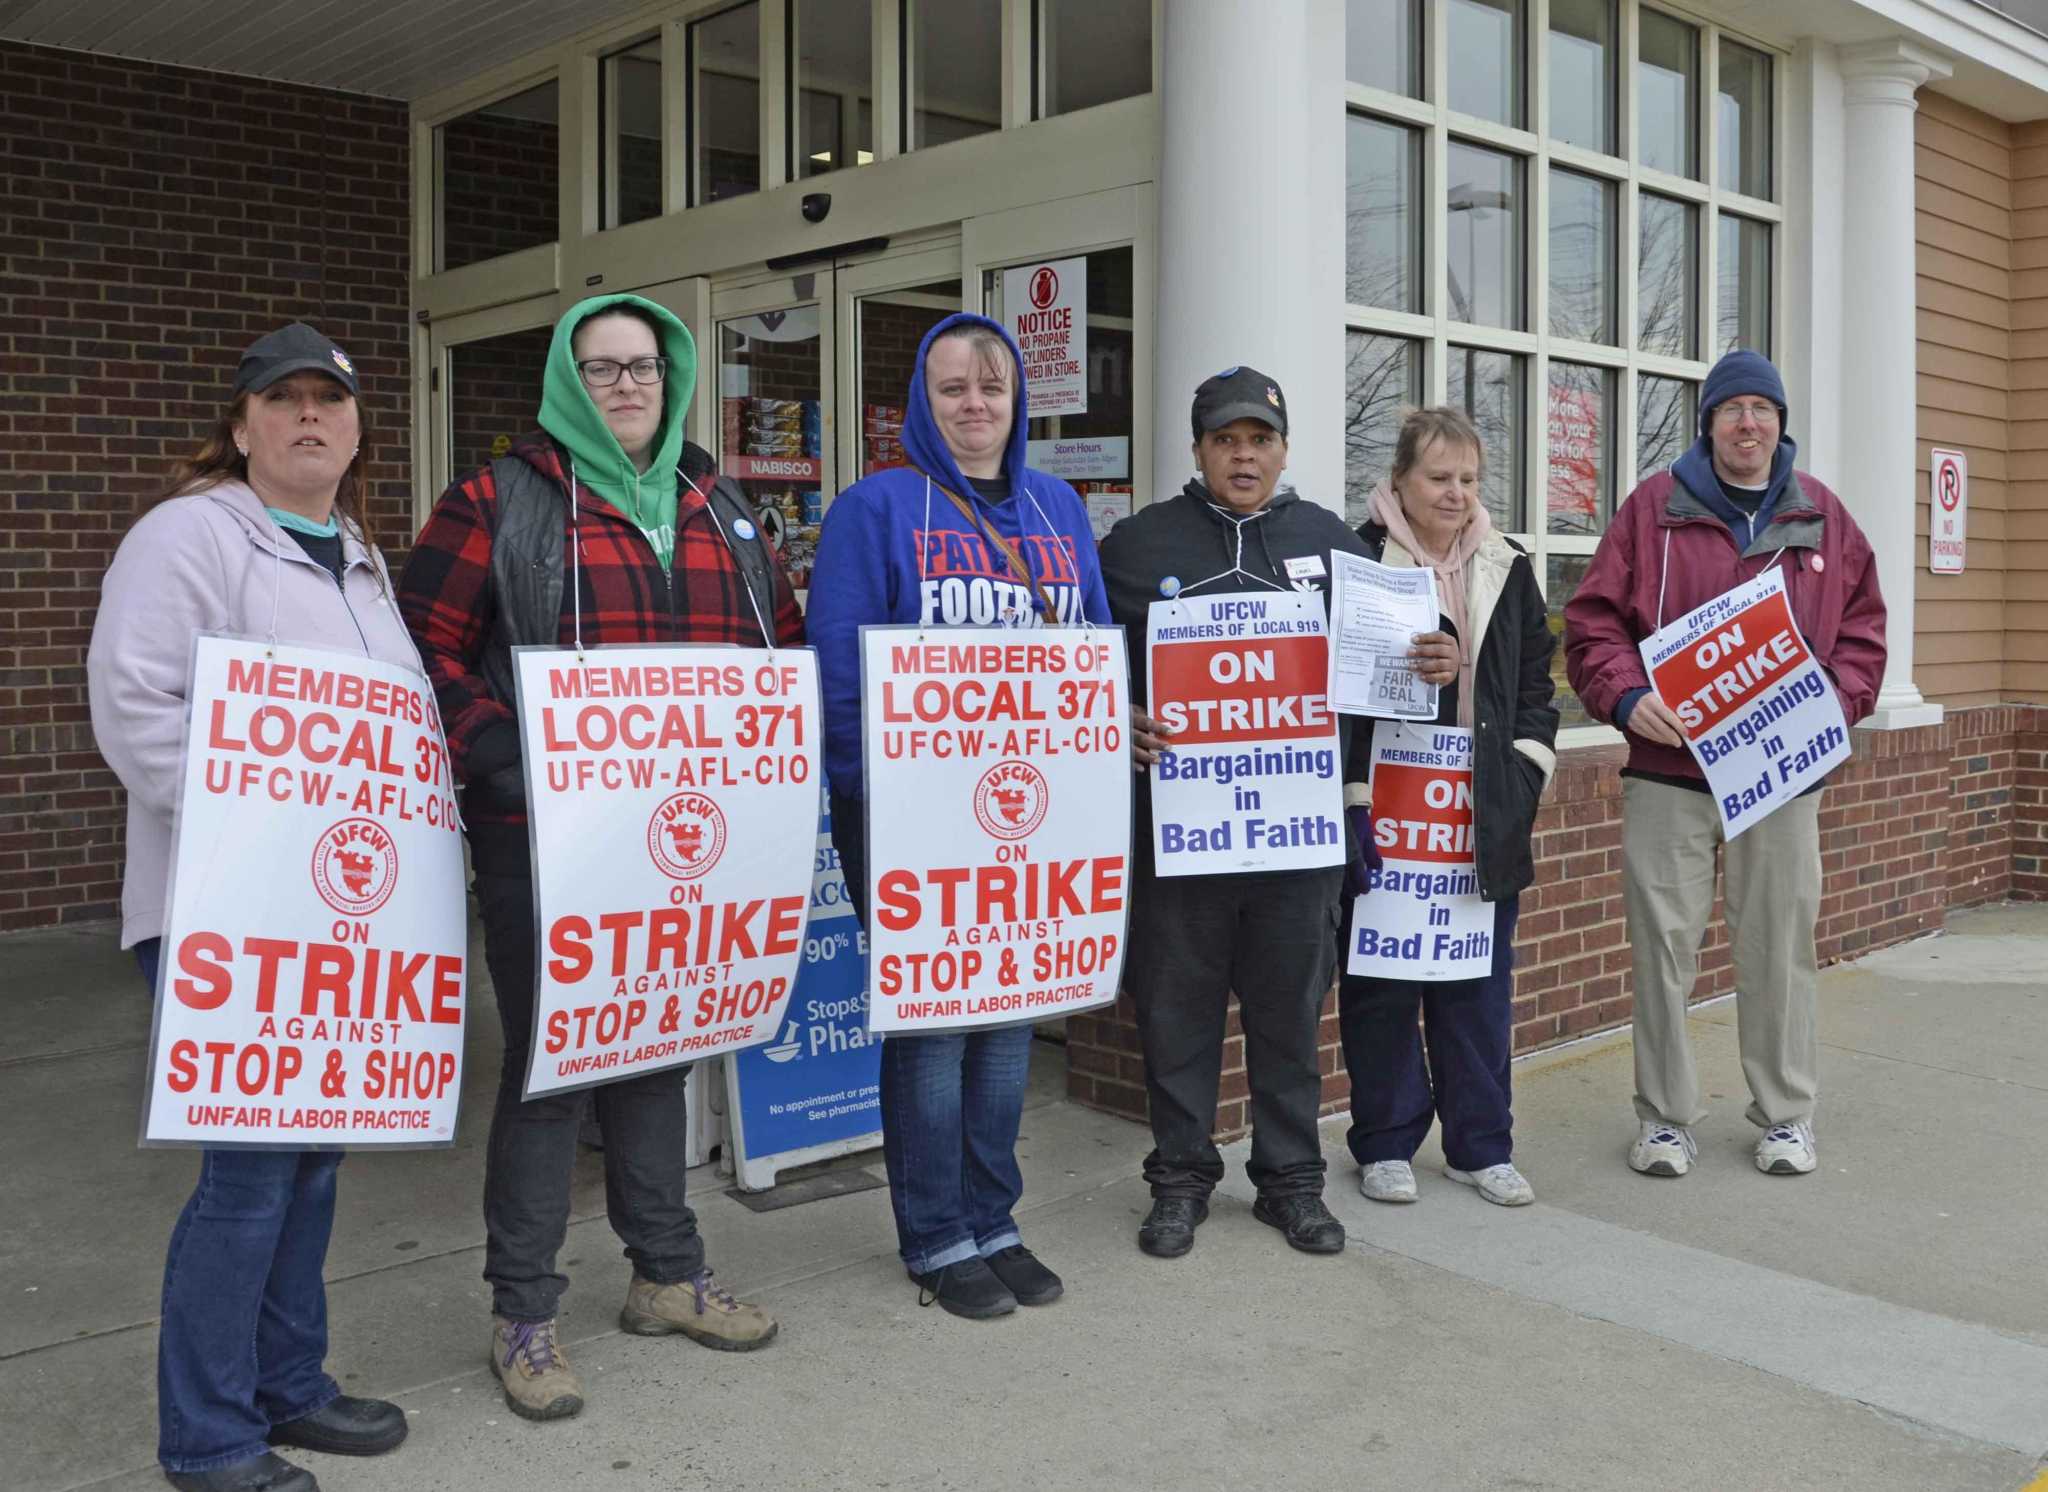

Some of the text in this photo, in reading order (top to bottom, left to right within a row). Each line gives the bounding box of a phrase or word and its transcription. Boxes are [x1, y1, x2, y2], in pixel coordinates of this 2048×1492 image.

[1018, 307, 1072, 335] NOTICE
[1019, 331, 1070, 350] NO PROPANE
[1022, 346, 1066, 365] CYLINDERS
[1045, 363, 1054, 377] IN
[1054, 442, 1102, 454] Store Hours
[751, 460, 812, 475] NABISCO
[915, 530, 1078, 583] PATOTS
[1211, 601, 1267, 621] UFCW
[1651, 585, 1777, 665] MEMBERS OF LOCAL 919
[1687, 597, 1731, 629] UFCW
[1157, 620, 1320, 641] MEMBERS OF LOCAL 919
[1695, 623, 1746, 670] ON
[891, 645, 1109, 674] MEMBERS OF
[1209, 650, 1276, 684] ON
[549, 666, 798, 698] MEMBERS OF
[1378, 685, 1416, 702] DEAL
[1384, 670, 1413, 686] FAIR
[1676, 629, 1799, 729] STRIKE
[227, 659, 438, 733] MEMBERS O
[882, 680, 1116, 723] LOCAL 371
[542, 704, 803, 752] LOCAL 371
[1160, 694, 1329, 734] STRIKE
[1696, 670, 1825, 767] Bargaining
[209, 699, 404, 776] LOCAL
[883, 725, 1120, 759] UFCW-AFL-CIO
[1761, 732, 1785, 759] in
[1158, 746, 1334, 785] Bargaining
[1381, 748, 1442, 765] MEMBERS
[1446, 754, 1461, 766] OF
[1722, 723, 1844, 822] Bad Faith
[547, 755, 808, 792] UFCW-AFL-CIO
[987, 766, 1038, 787] UFCW
[205, 759, 457, 832] UFCW-AFL-CIO
[661, 798, 714, 822] UFCW
[1234, 785, 1261, 811] in
[1424, 779, 1472, 810] ON
[331, 824, 389, 852] UFCW
[1161, 815, 1338, 853] Bad Faith
[1374, 817, 1473, 853] STRI
[995, 844, 1027, 863] ON
[670, 884, 702, 905] ON
[877, 856, 1124, 932] STRIKE
[1369, 866, 1479, 900] Bargaini
[1429, 903, 1450, 926] in
[332, 919, 369, 945] ON
[548, 896, 804, 984] STRIKE
[806, 932, 848, 963] 90%
[946, 920, 1063, 946] AGAINST
[1357, 927, 1490, 961] Bad Faith
[174, 931, 462, 1024] STRIKE
[614, 964, 733, 997] AGAINST
[879, 934, 1117, 996] STOP & SHOP
[545, 977, 787, 1054] STOP & SHOP
[807, 991, 870, 1021] Stop&S
[897, 983, 1093, 1019] UNFAIR LABOR PRACTICE
[259, 1016, 402, 1044] AGAINST
[558, 1024, 754, 1077] UNFAIR LABOR PRACTICE
[167, 1039, 455, 1100] STOP & SHOP
[187, 1105, 430, 1129] UNFAIR LABOR PRACTICE
[769, 1105, 784, 1115] No
[786, 1091, 845, 1112] appointment
[847, 1088, 857, 1098] or
[808, 1096, 880, 1121] See pharmacist
